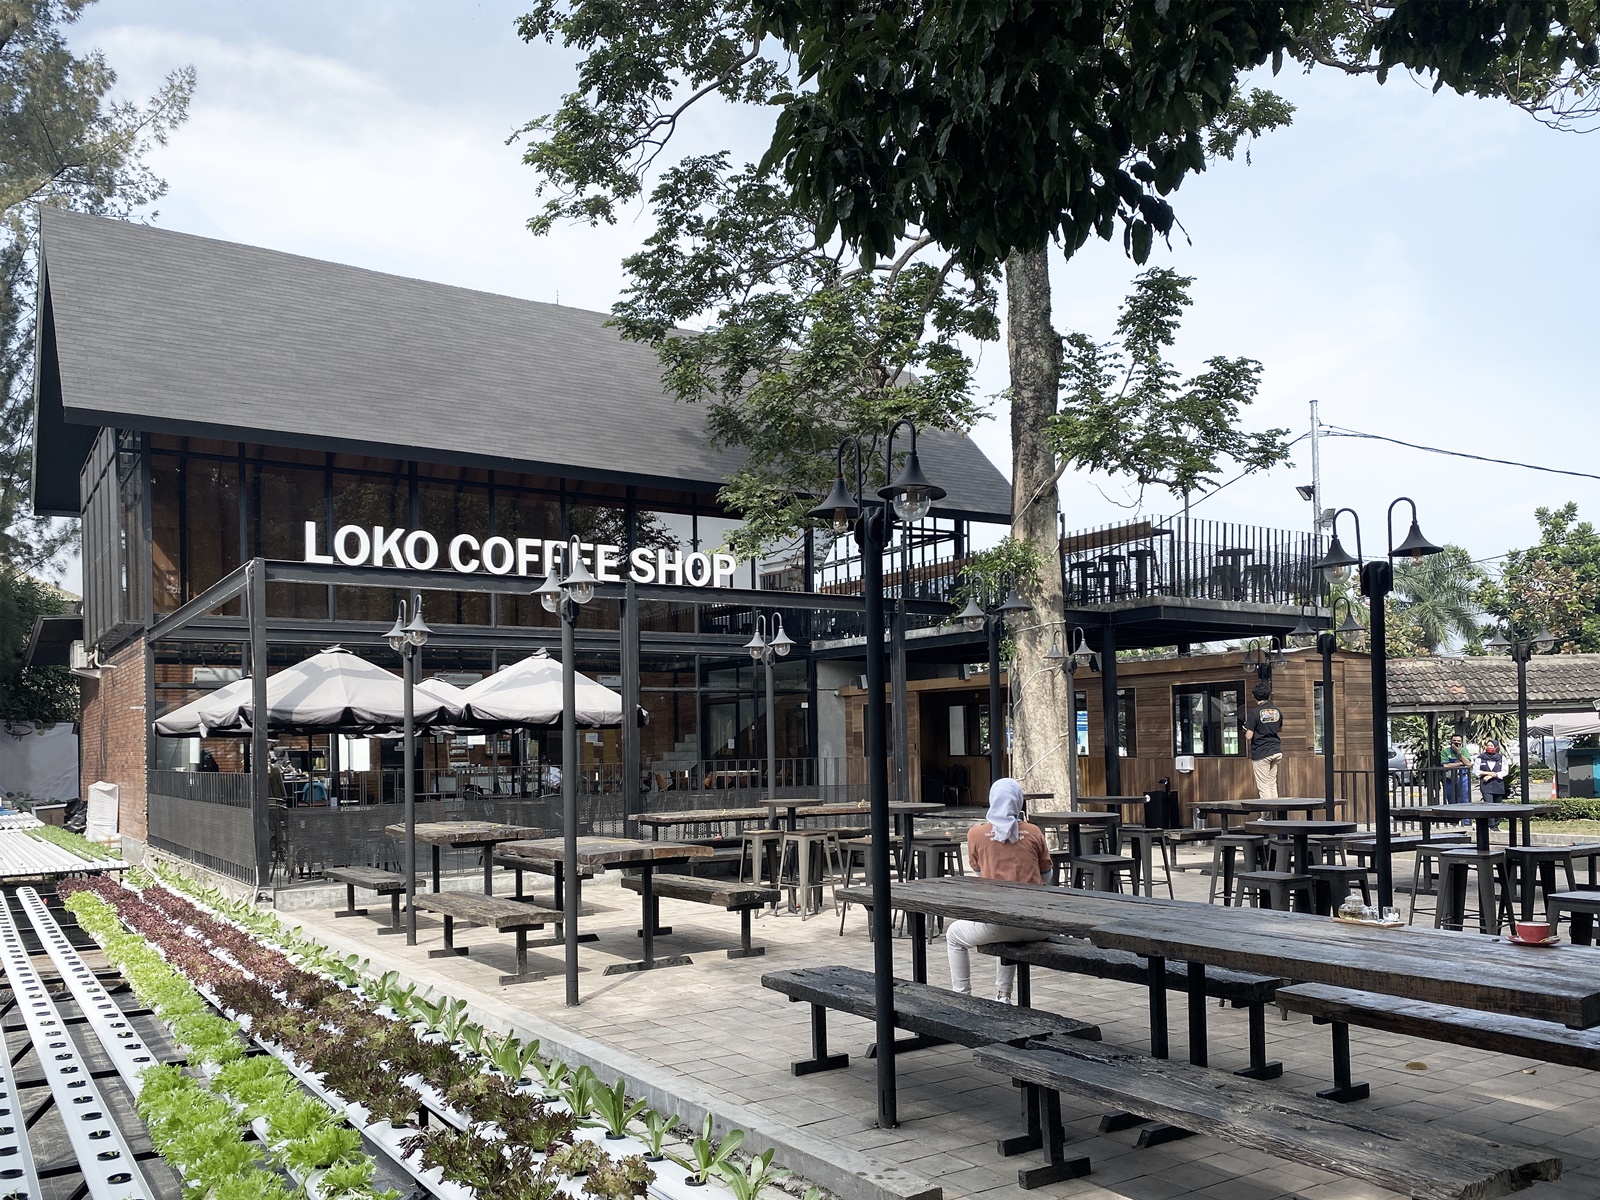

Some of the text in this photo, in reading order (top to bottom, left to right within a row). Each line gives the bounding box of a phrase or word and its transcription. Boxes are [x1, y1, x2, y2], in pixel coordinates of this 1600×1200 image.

[305, 521, 736, 588] LOKO COFFEE SHOP
